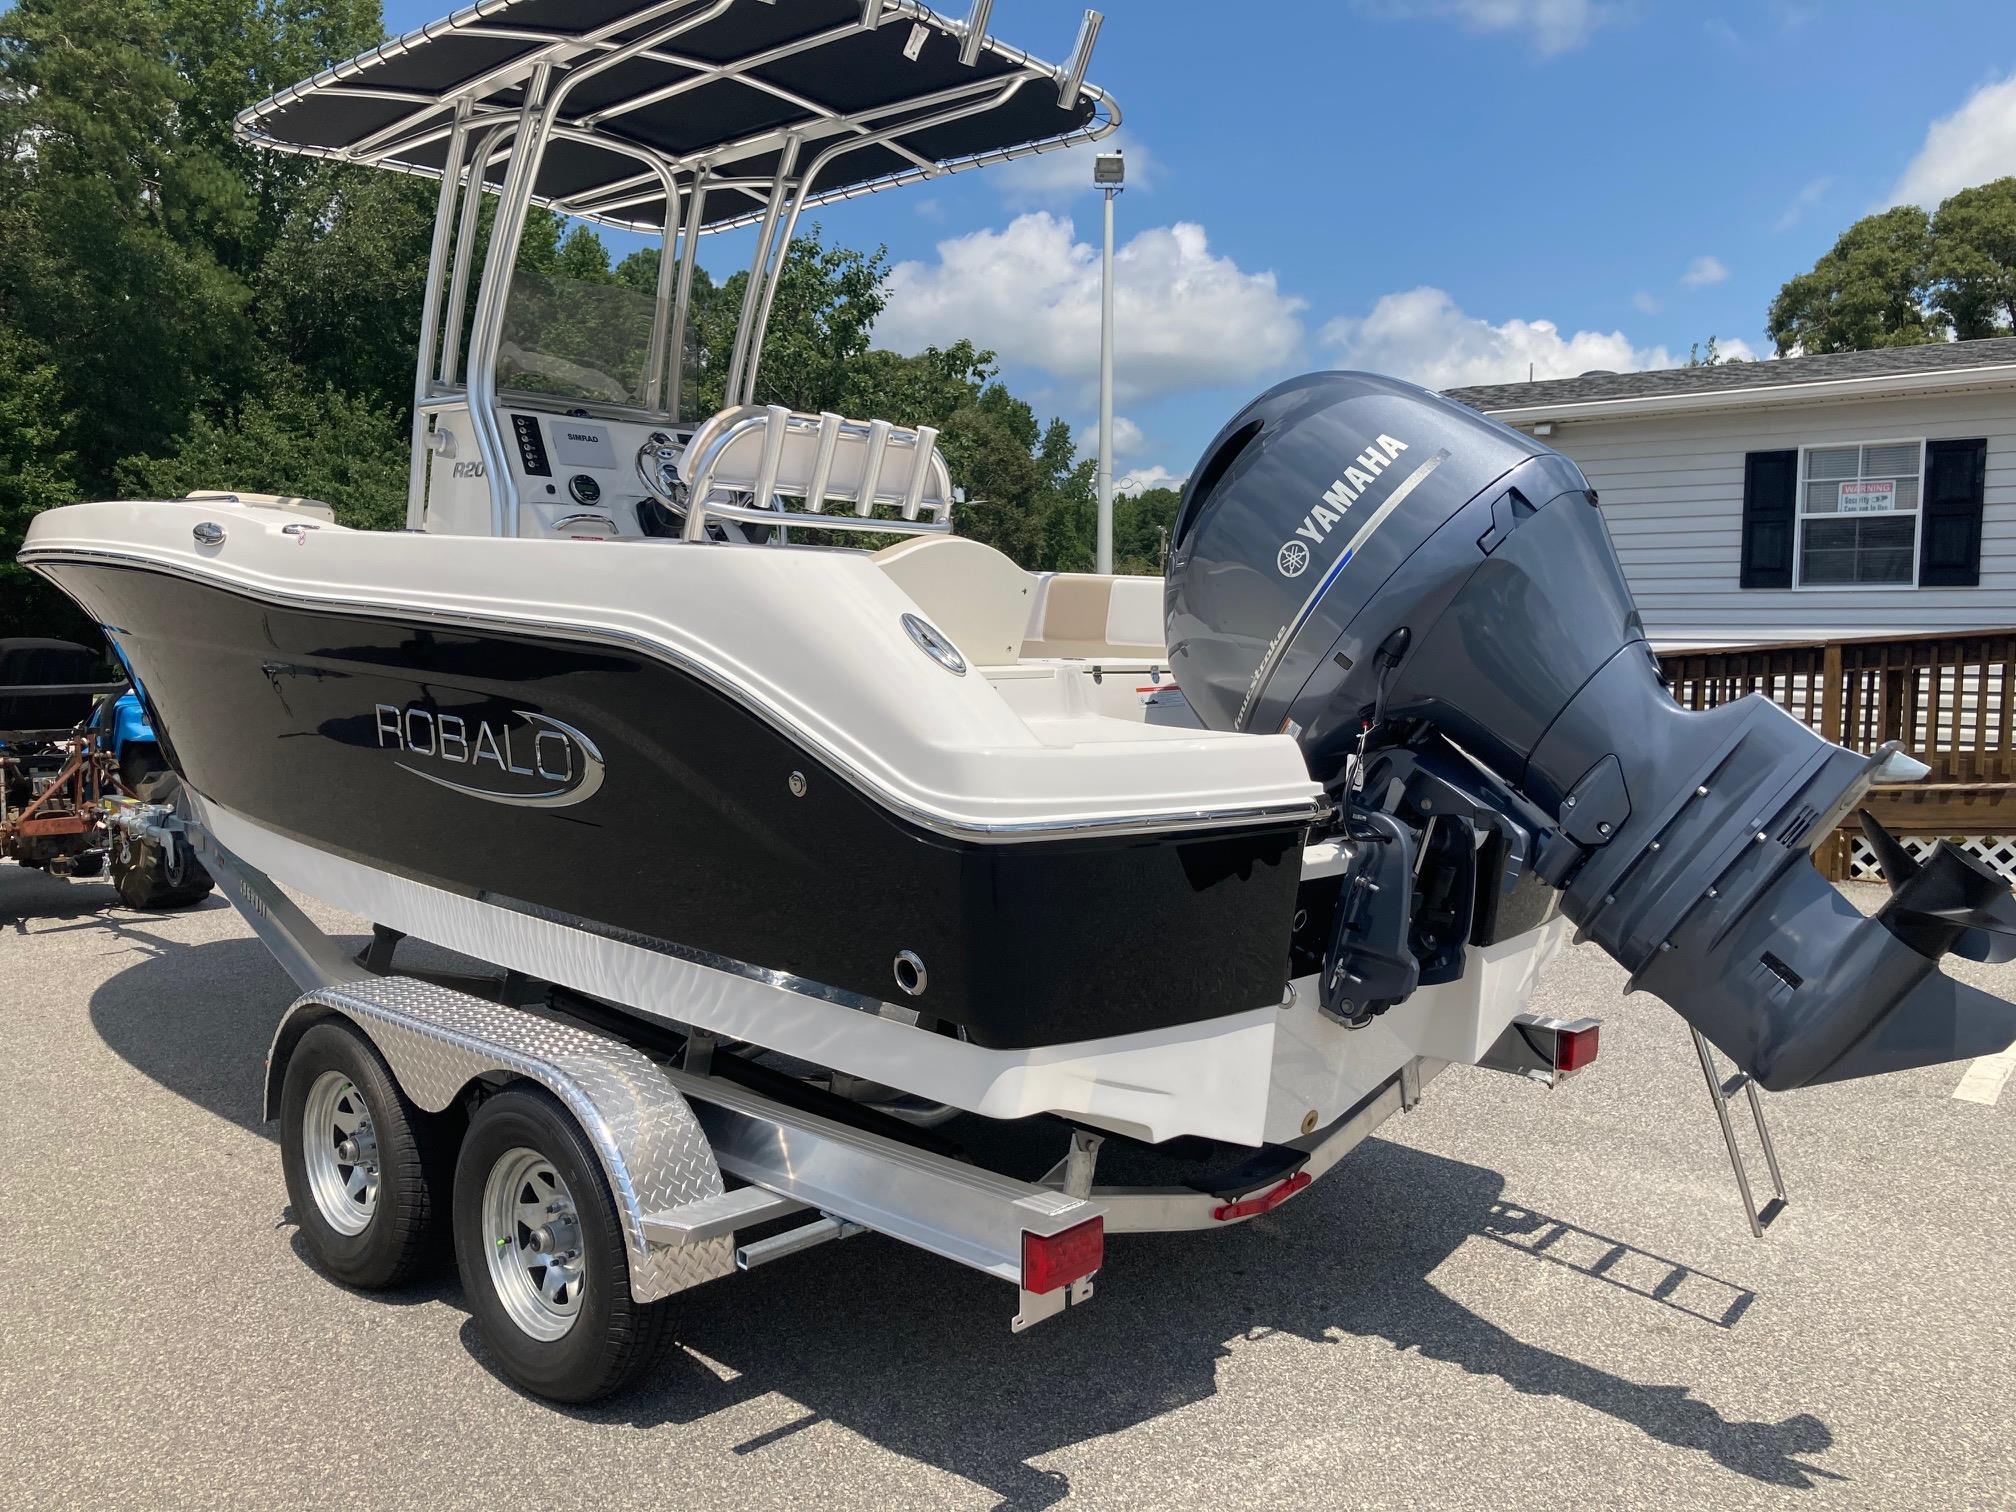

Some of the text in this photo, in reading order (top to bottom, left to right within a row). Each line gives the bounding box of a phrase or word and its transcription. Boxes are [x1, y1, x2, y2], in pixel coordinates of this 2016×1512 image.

[567, 433, 599, 443] SIMRAD
[1295, 433, 1409, 544] YAMAHA
[375, 703, 573, 782] ROBALO
